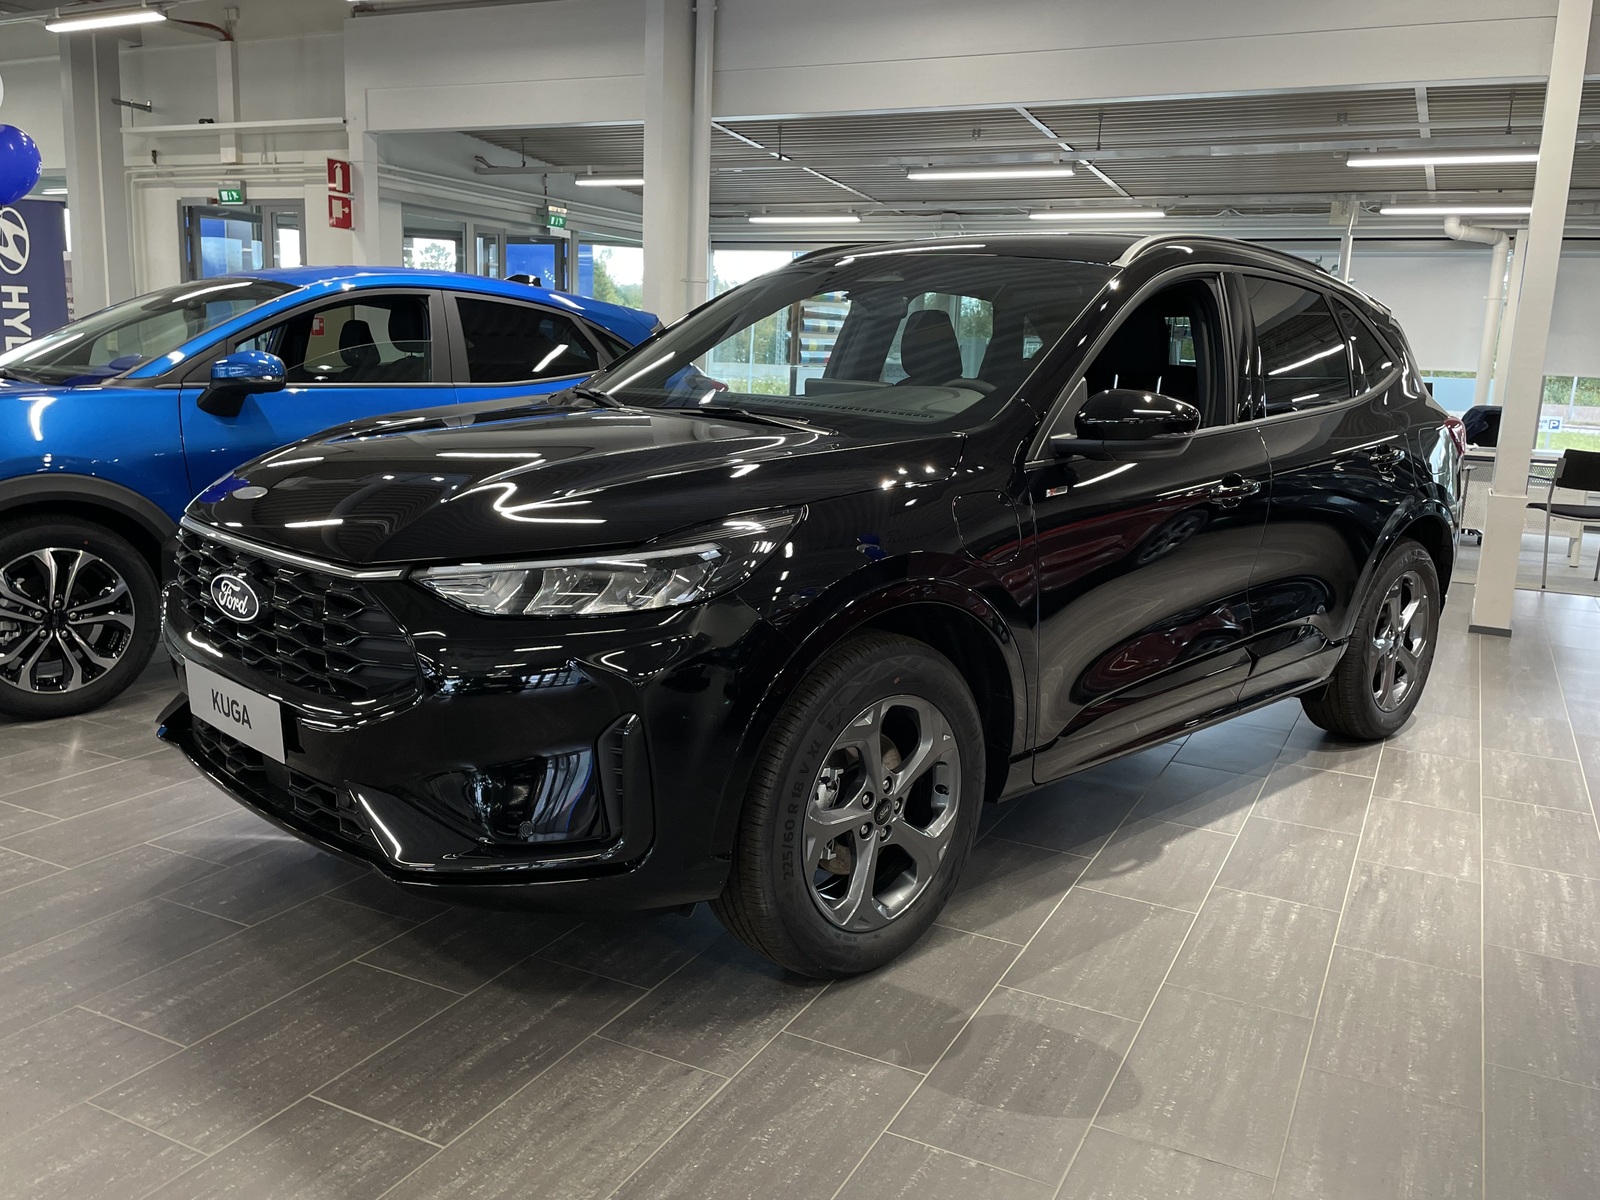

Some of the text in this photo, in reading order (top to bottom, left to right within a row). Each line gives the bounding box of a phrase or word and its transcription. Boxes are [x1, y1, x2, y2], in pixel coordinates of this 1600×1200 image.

[219, 580, 248, 615] Ford
[211, 688, 252, 730] KUGA
[782, 740, 823, 881] 225/60 R 18 V XL
